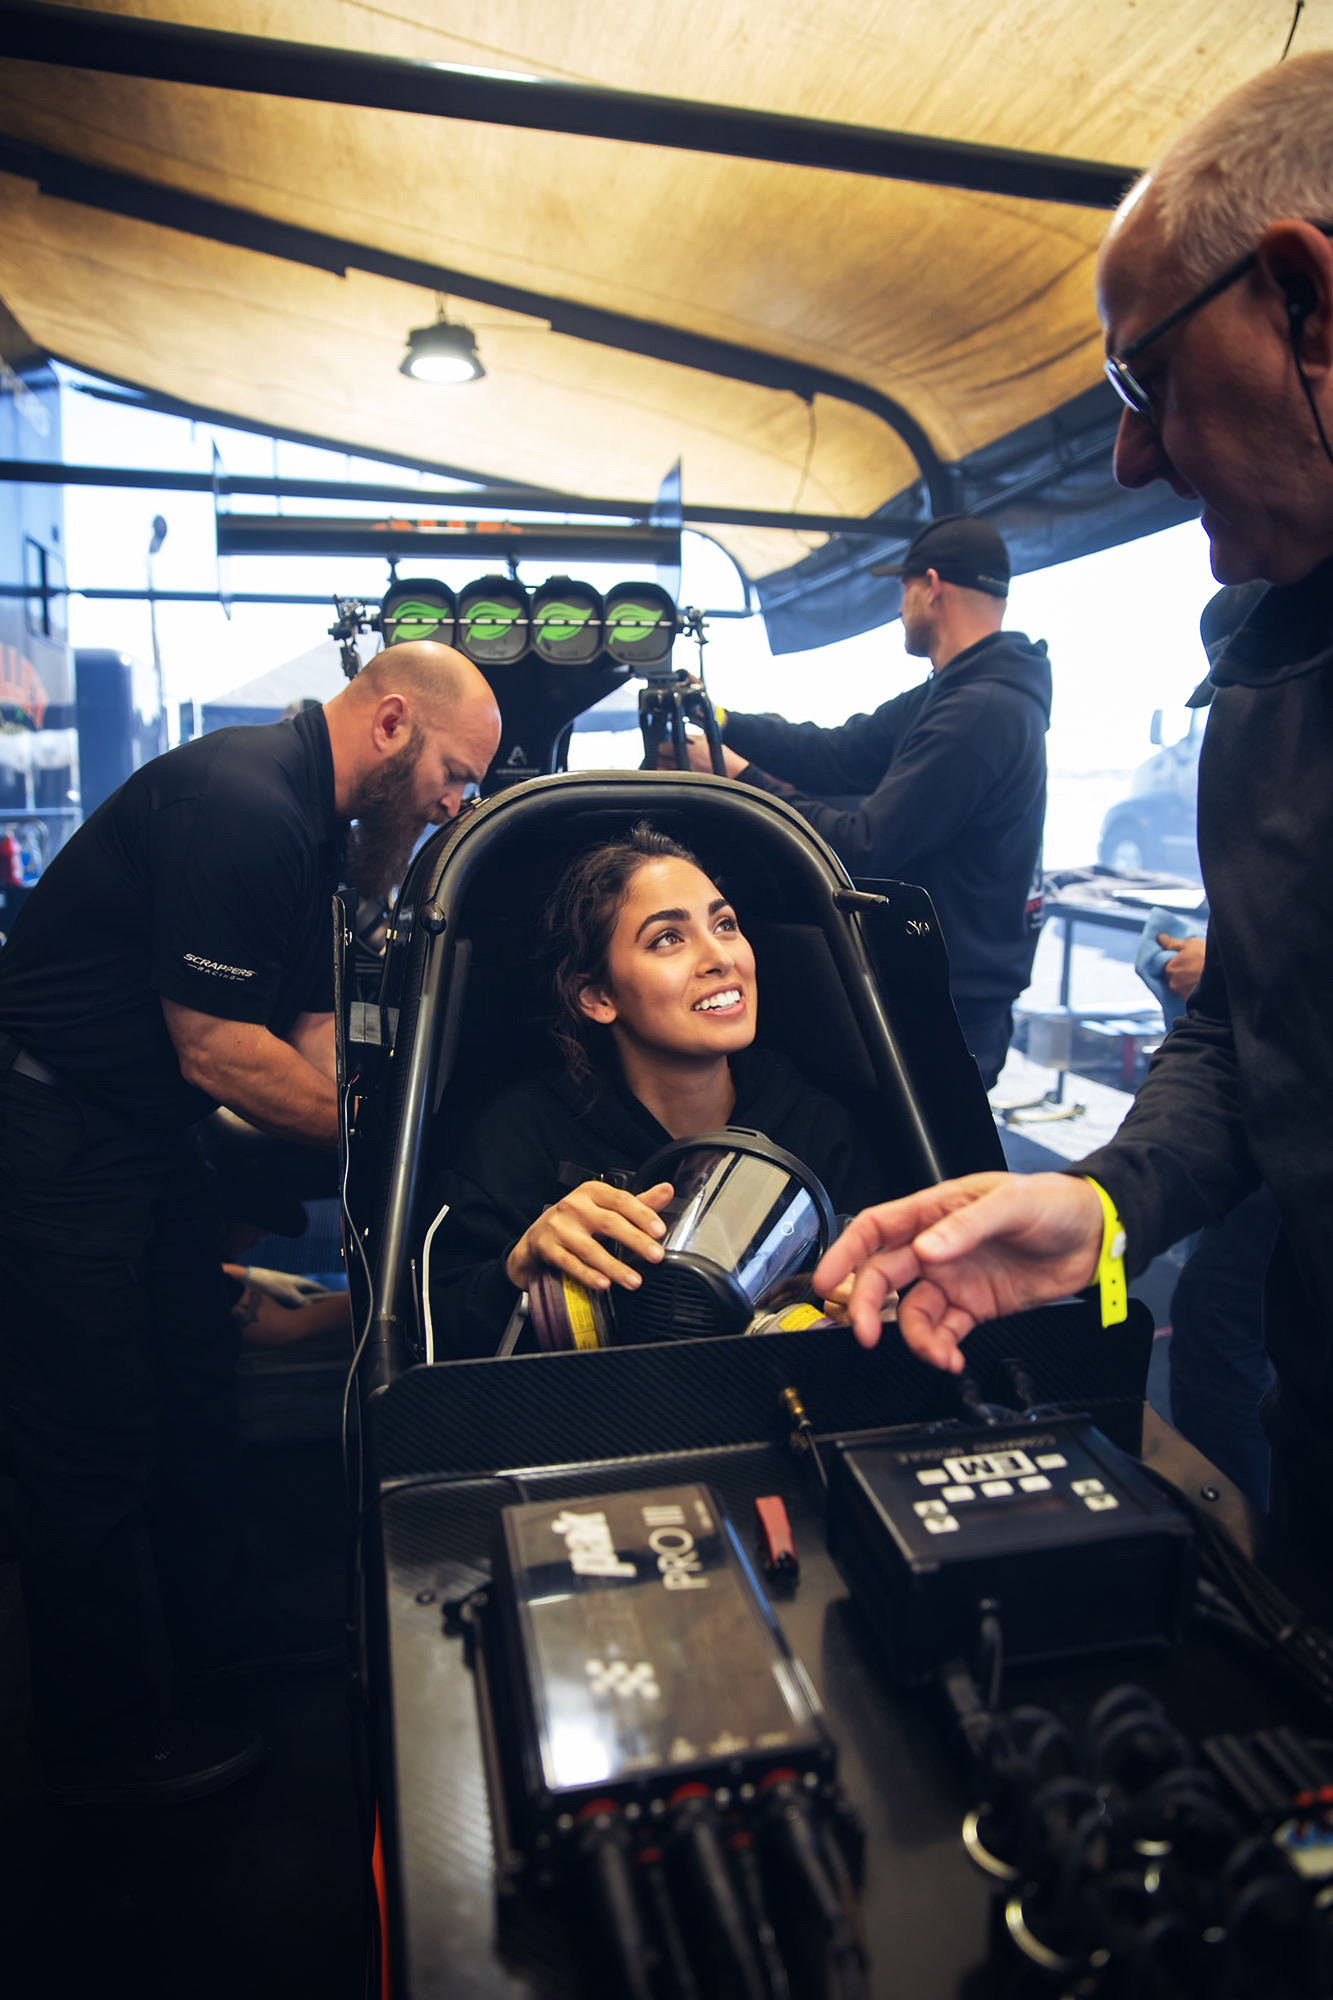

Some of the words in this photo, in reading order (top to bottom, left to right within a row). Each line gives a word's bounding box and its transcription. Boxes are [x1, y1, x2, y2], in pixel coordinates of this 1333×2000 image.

[183, 953, 256, 977] SCRAPPERS
[197, 966, 236, 980] RACING
[648, 1527, 709, 1590] PRO
